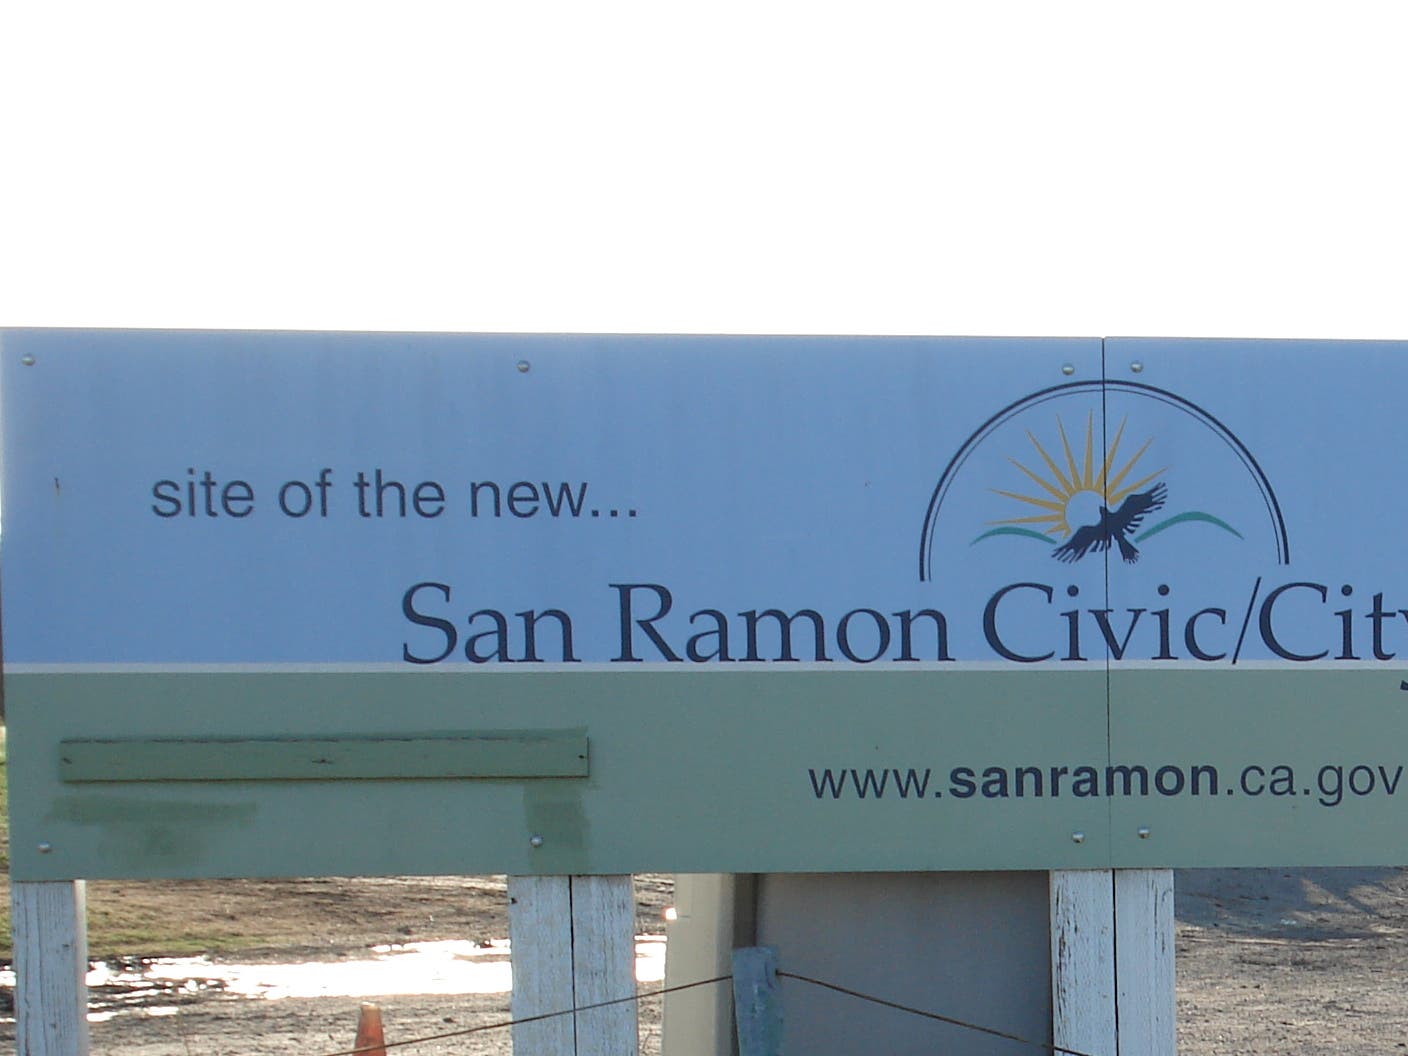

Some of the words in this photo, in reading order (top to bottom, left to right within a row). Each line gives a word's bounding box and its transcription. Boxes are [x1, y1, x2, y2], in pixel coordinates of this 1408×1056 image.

[152, 467, 255, 518] site
[278, 468, 333, 518] of
[353, 468, 446, 519] the
[470, 481, 637, 519] new...
[401, 582, 582, 664] San
[608, 582, 957, 664] Ramon
[808, 759, 1404, 808] www.sanramon.ca.gov
